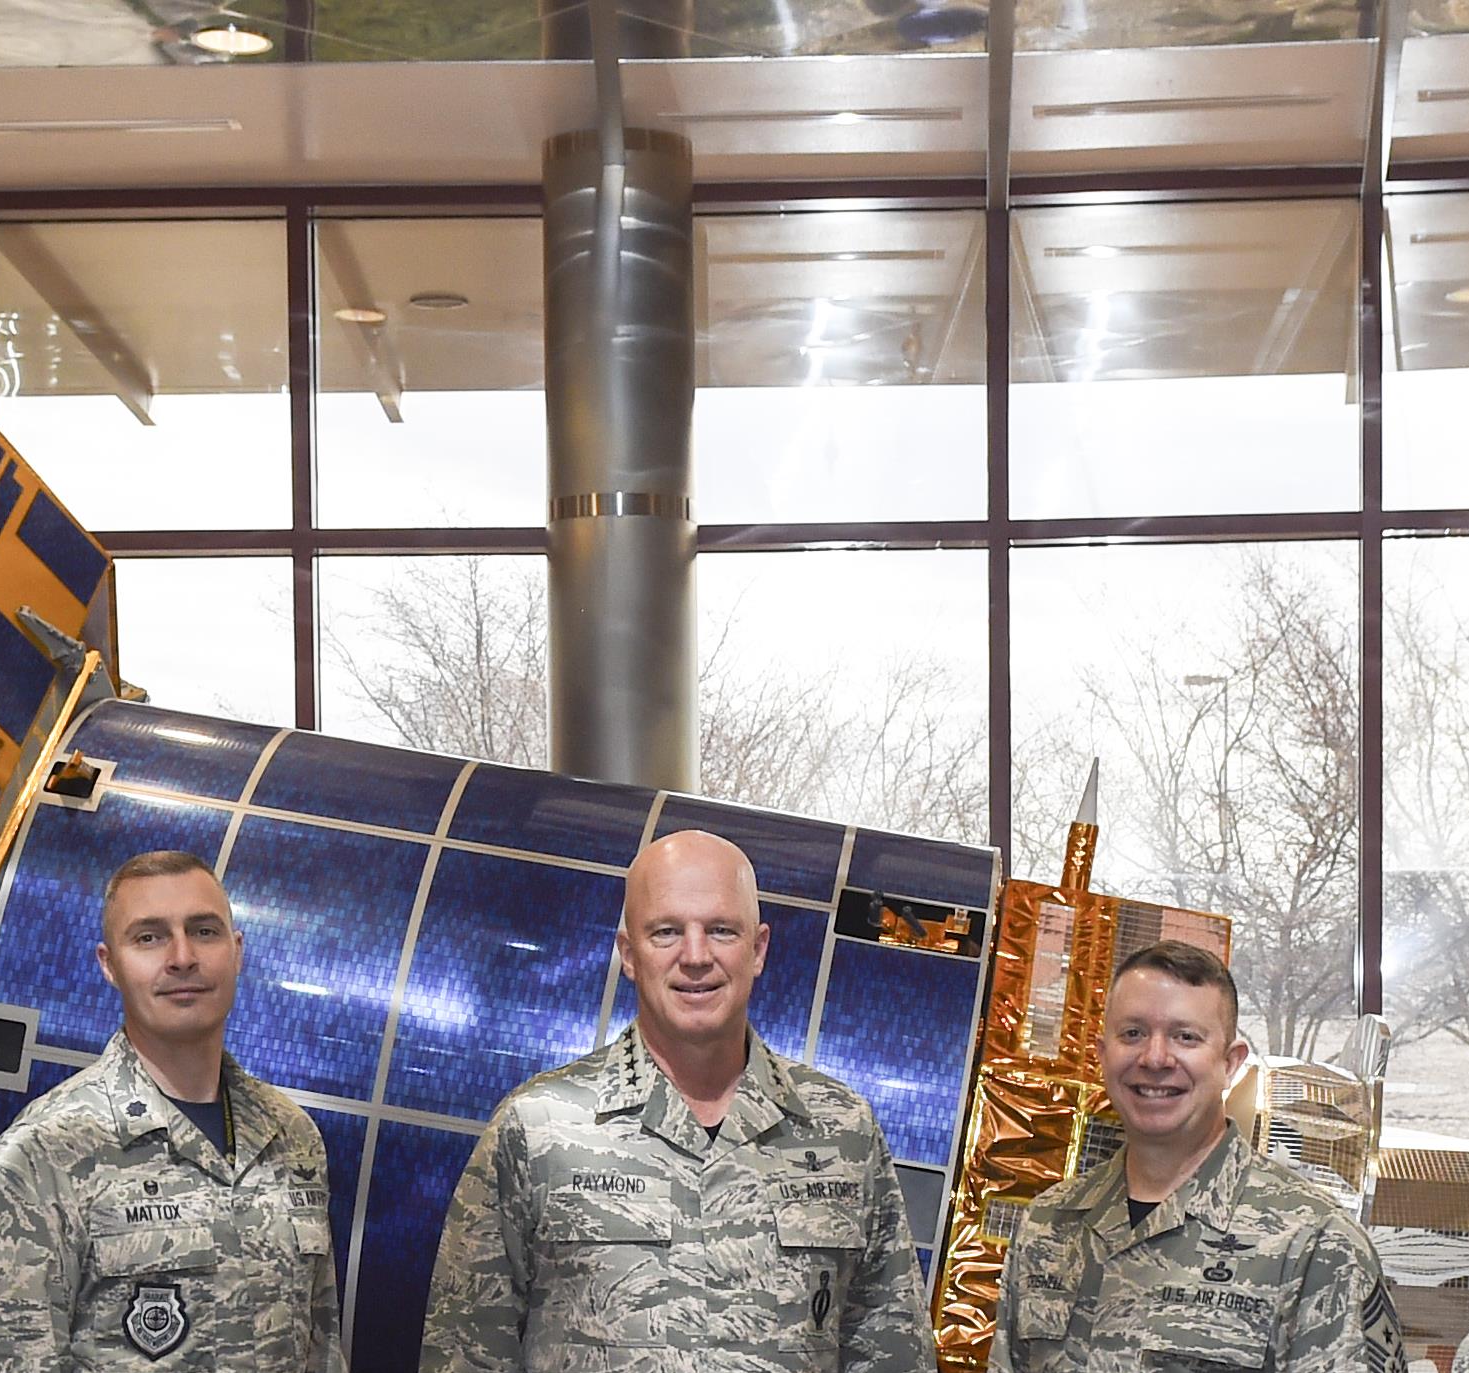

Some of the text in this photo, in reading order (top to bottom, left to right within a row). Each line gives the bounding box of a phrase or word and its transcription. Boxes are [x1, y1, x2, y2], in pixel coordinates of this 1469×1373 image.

[572, 1174, 646, 1194] RAYMOND
[807, 1182, 826, 1198] AIR
[828, 1182, 860, 1200] FORCE
[125, 1204, 182, 1224] MATTOX
[1162, 1286, 1263, 1314] U.S. AIR FORCE
